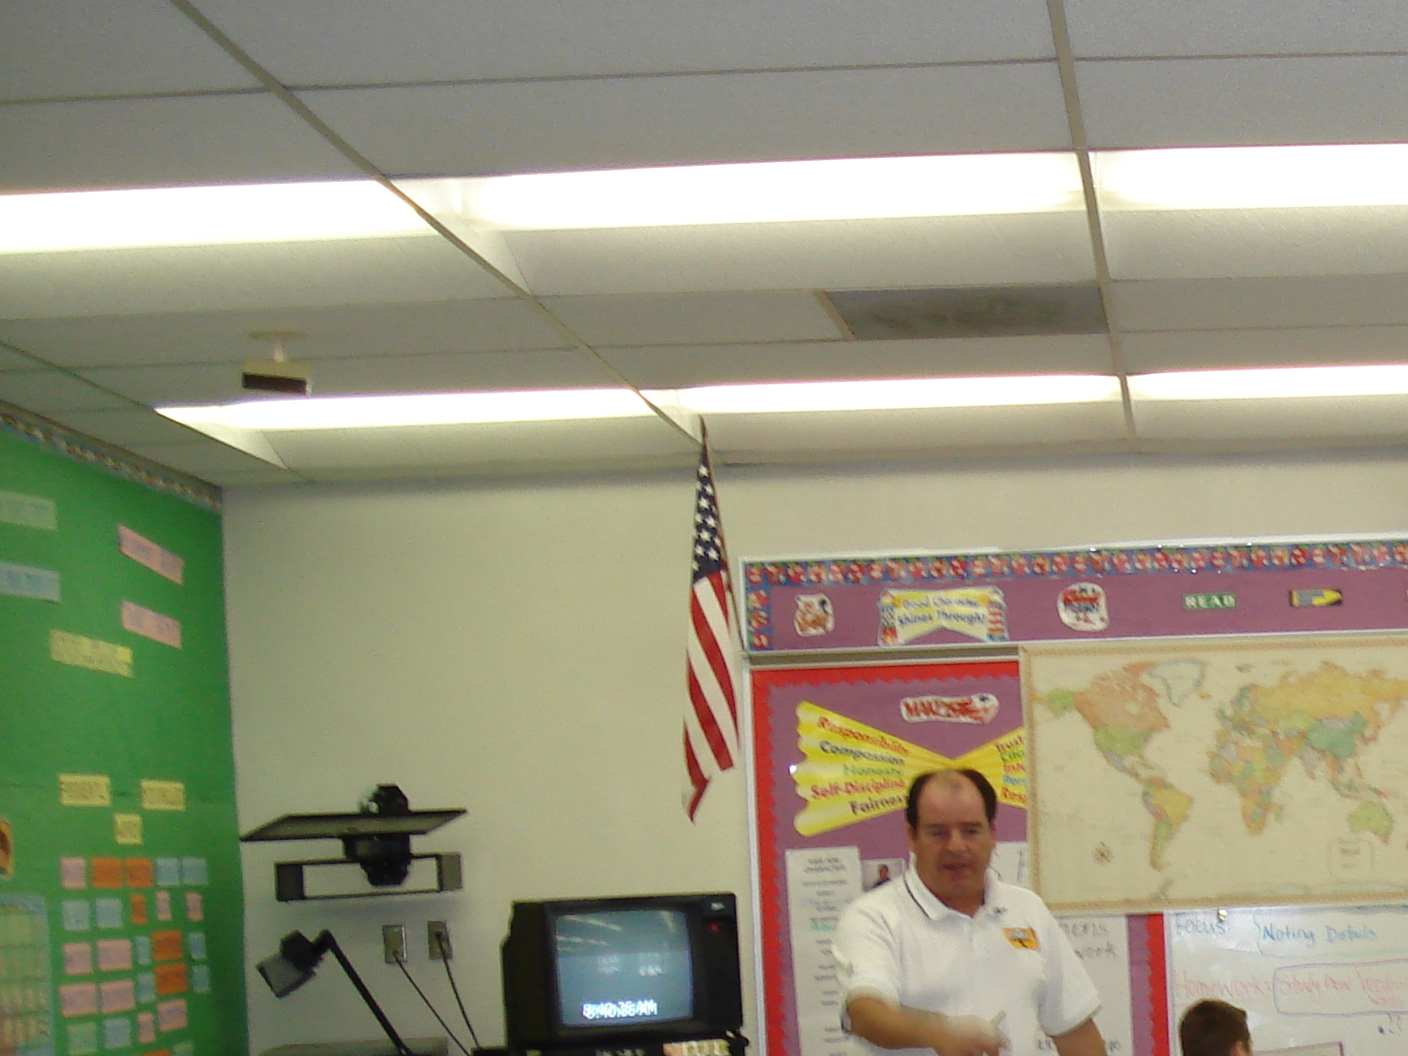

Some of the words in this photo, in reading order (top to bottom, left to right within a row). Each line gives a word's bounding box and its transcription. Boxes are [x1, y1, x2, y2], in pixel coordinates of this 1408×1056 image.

[1184, 594, 1237, 609] READ
[1175, 911, 1227, 936] Focus
[1261, 923, 1317, 950] Noting
[636, 999, 659, 1016] AM
